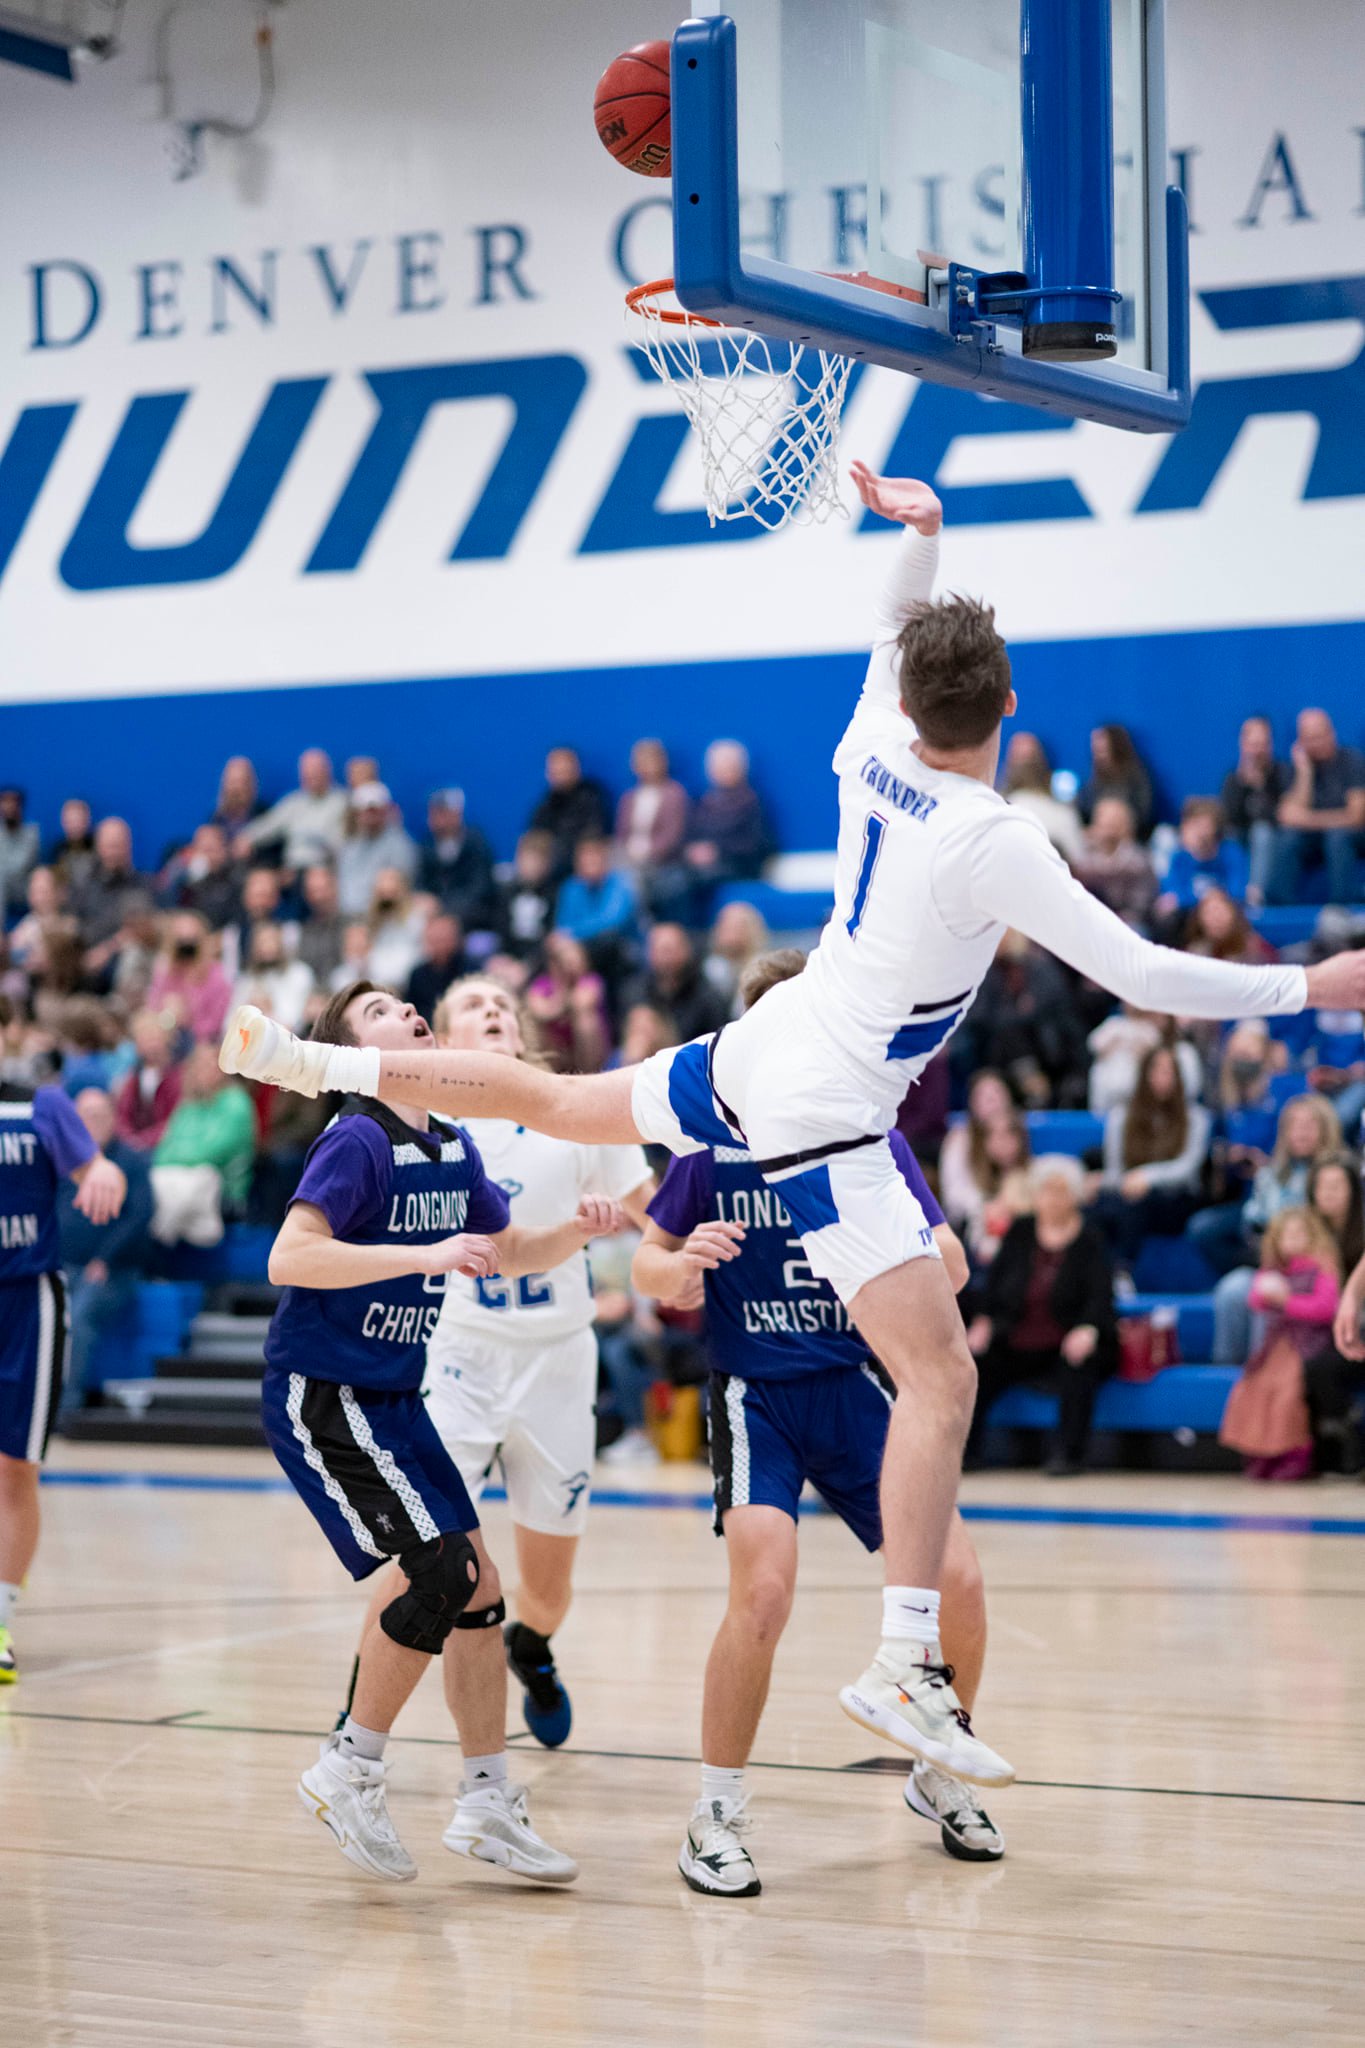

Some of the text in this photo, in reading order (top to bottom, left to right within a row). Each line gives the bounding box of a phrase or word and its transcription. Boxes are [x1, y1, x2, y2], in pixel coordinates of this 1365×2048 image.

[26, 125, 1365, 353] DENVER CHRISIA
[0, 272, 1365, 592] UNDER
[860, 756, 939, 824] THUNDER
[844, 810, 889, 942] 1
[361, 1302, 440, 1345] CHRIS
